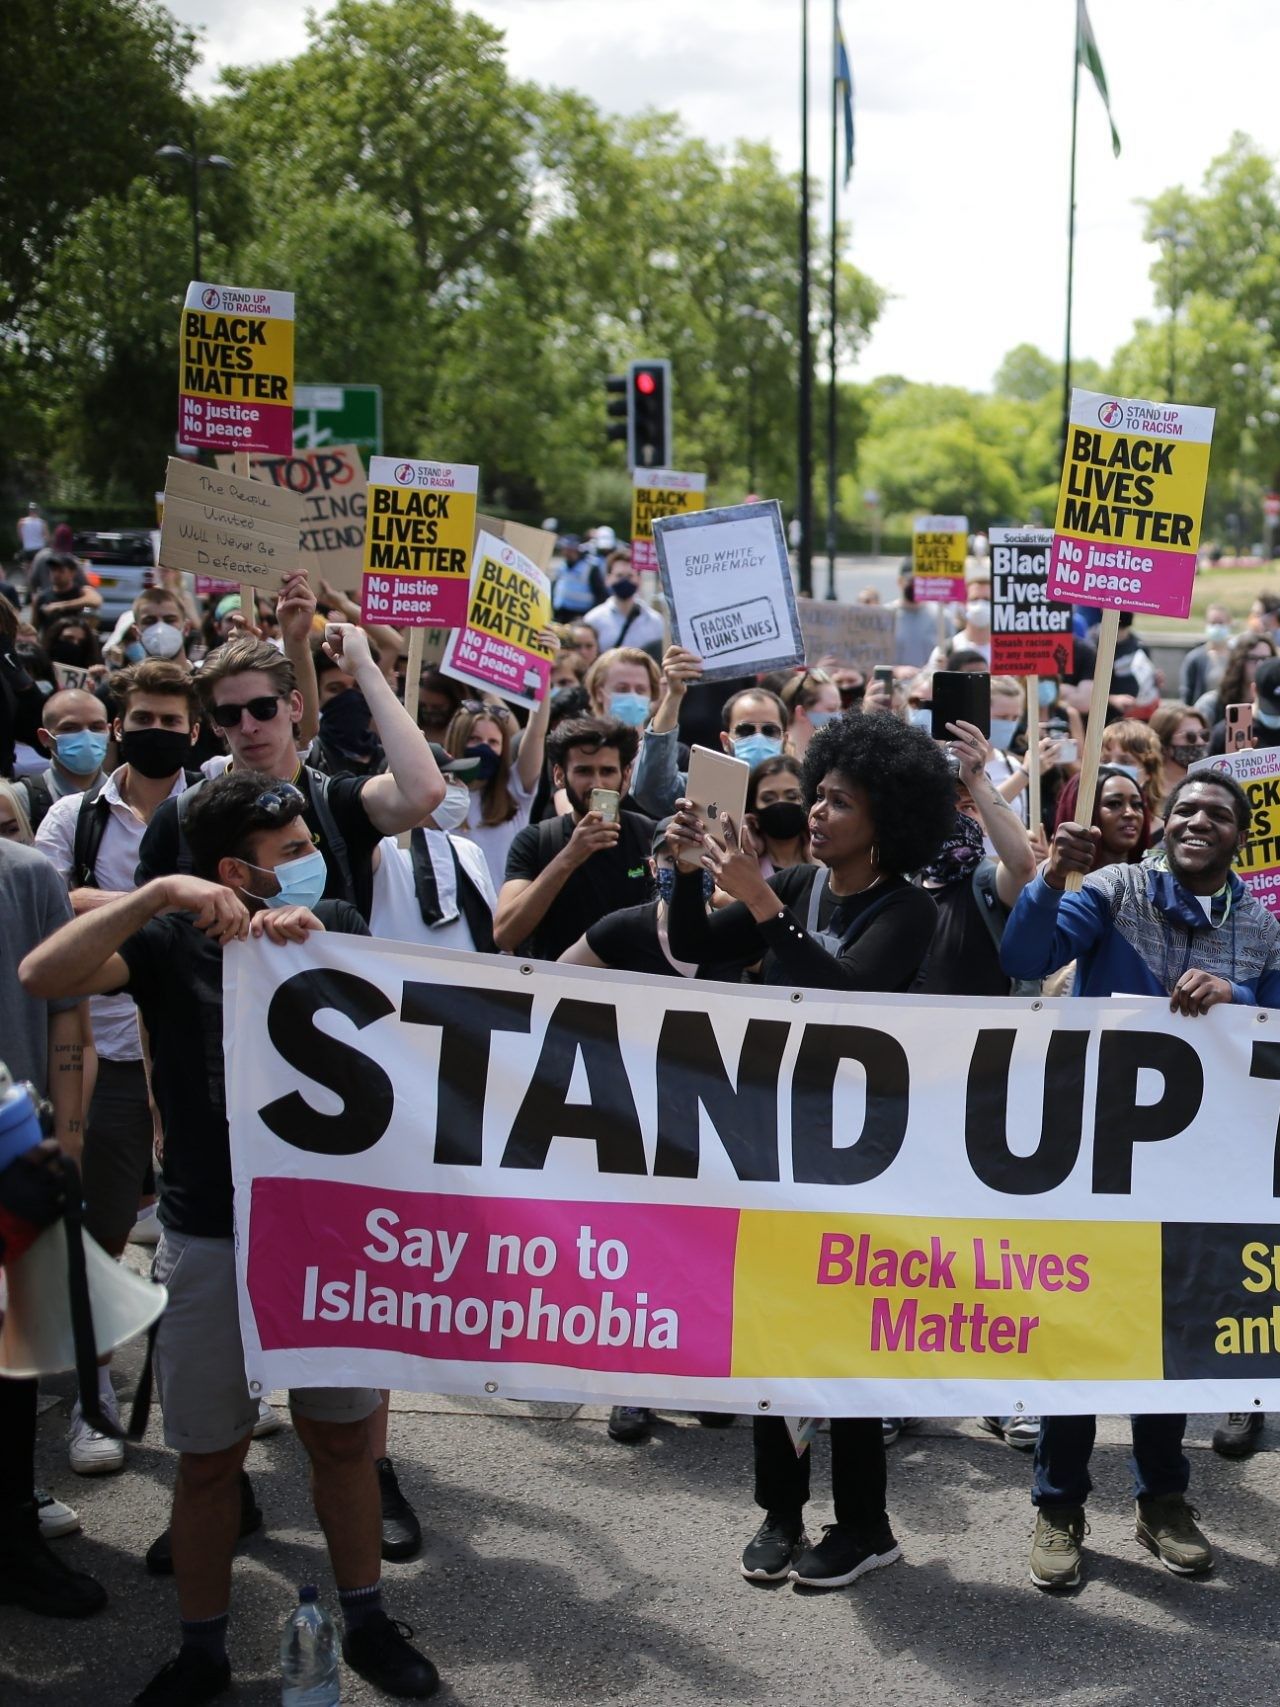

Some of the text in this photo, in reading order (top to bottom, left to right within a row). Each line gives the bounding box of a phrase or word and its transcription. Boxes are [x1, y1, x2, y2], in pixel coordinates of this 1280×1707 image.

[222, 292, 266, 303] STAND UP
[223, 302, 271, 314] TO RACISM
[186, 312, 267, 345] BLACK
[185, 339, 253, 370] LIVES
[185, 366, 288, 400] MATTER
[184, 399, 260, 421] No justice
[1127, 406, 1178, 422] STAND UP
[184, 416, 252, 437] No peace
[1126, 418, 1183, 435] TO RACISM
[1072, 429, 1176, 475] BLACK
[200, 476, 224, 494] The
[418, 467, 441, 477] STAND
[418, 477, 428, 486] TO
[1067, 464, 1155, 507] LIVES
[374, 489, 450, 518] BLACK
[637, 489, 687, 507] BLACK
[372, 517, 438, 544] LIVES
[1063, 498, 1193, 546] MATTER
[1004, 533, 1036, 543] Socialist
[198, 551, 269, 575] Defeated
[370, 543, 466, 573] MATTER
[685, 547, 753, 566] END WHITE
[685, 555, 766, 577] SUPREMACY
[1058, 540, 1153, 573] No justice
[368, 577, 438, 597] No justice
[482, 560, 541, 606] BLACK
[1055, 562, 1141, 594] No peace
[367, 594, 431, 614] No peace
[476, 580, 530, 622] LIVES
[700, 612, 743, 636] RACISM
[993, 604, 1070, 632] Matter
[463, 629, 526, 666] No justice
[704, 620, 772, 651] RUINS LIVES
[458, 644, 477, 662] No
[479, 654, 517, 678] peace
[1235, 753, 1277, 769] STAND UP
[1236, 768, 1248, 778] TO
[257, 968, 910, 1186] STAND
[965, 1028, 1204, 1196] UP
[363, 1207, 629, 1283] Say no to
[817, 1232, 1090, 1293] Black Lives
[302, 1266, 679, 1351] Islamophobia
[870, 1297, 1040, 1355] Matter
